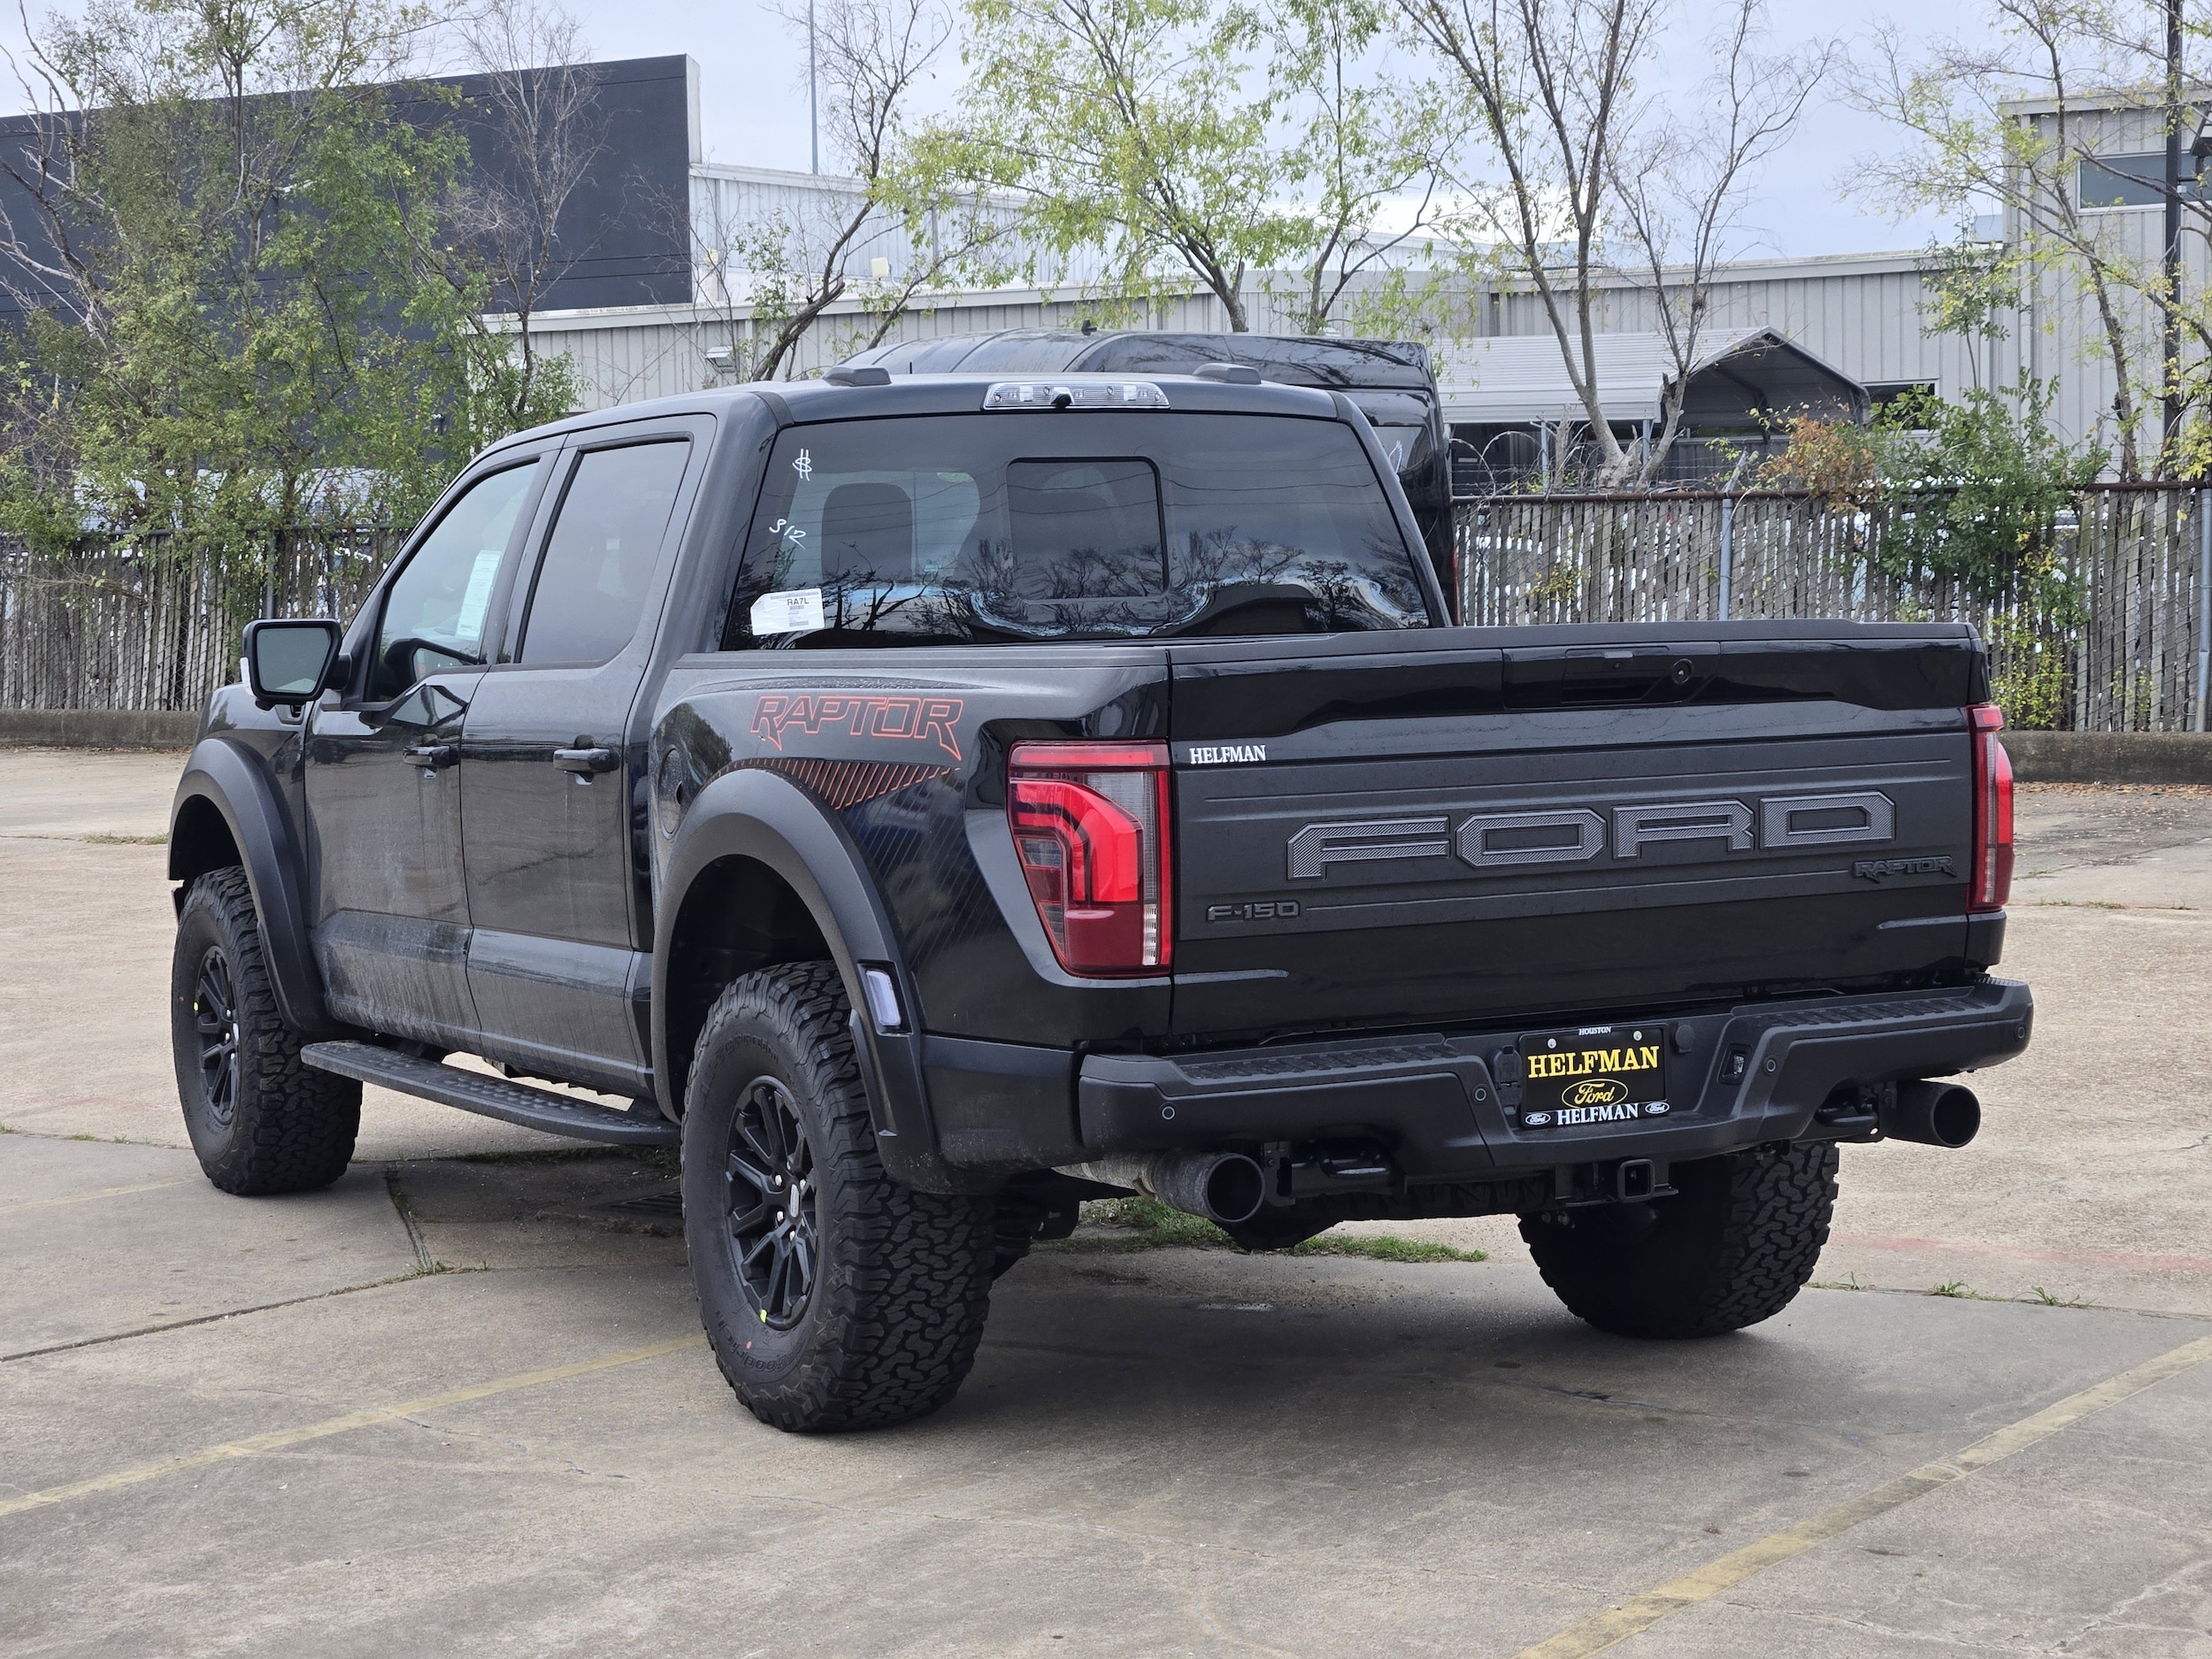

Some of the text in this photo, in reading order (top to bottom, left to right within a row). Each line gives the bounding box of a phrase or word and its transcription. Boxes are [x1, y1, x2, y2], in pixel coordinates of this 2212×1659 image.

[787, 597, 810, 606] RA7L
[750, 695, 964, 761] RAPTOR
[1189, 745, 1266, 764] HELFMAN
[1287, 789, 1895, 881] FORD
[1854, 855, 1957, 883] RAPTOR
[1207, 901, 1300, 922] F-150
[1578, 1025, 1612, 1036] HOUSTON
[1528, 1046, 1660, 1079] HELFMAN
[1574, 1082, 1616, 1105] Ford
[1556, 1102, 1640, 1125] HELFMAN
[1649, 1103, 1667, 1113] Ford
